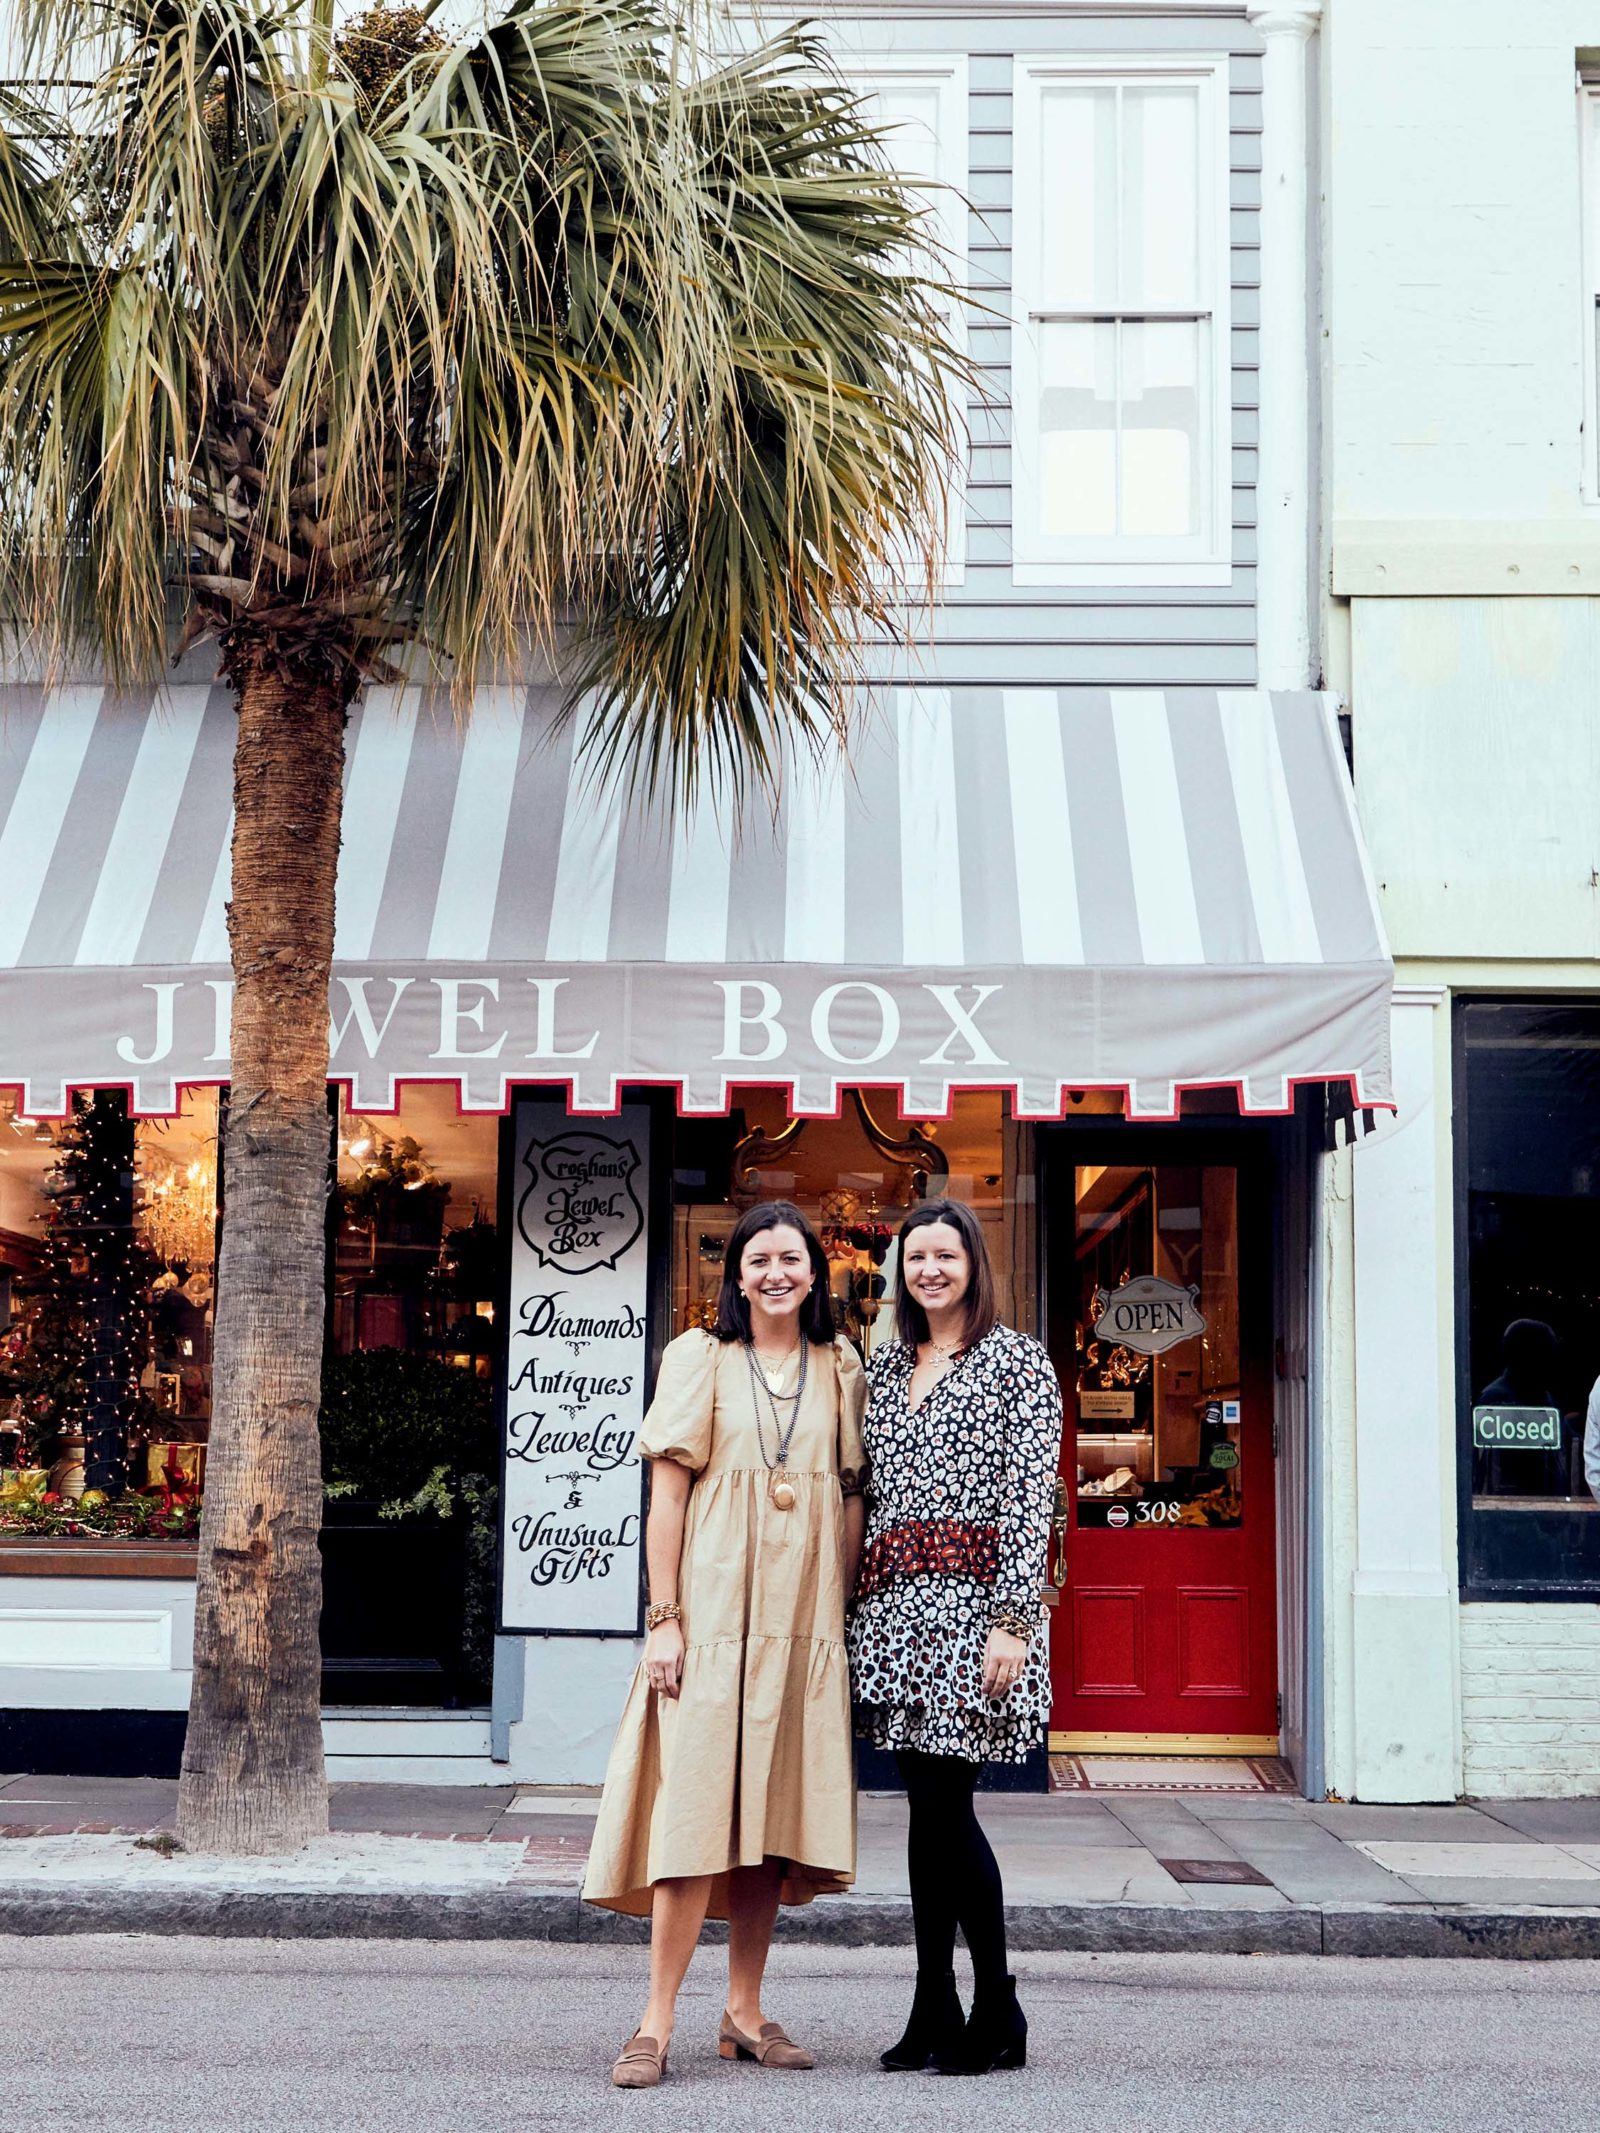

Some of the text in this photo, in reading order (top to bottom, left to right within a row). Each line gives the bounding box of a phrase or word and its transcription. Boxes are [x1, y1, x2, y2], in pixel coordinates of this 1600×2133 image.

[711, 979, 1010, 1066] BOX
[541, 1146, 628, 1188] Croghan's
[544, 1187, 625, 1225] Jewel
[548, 1222, 605, 1255] Box
[513, 1291, 648, 1339] Diamonds
[1115, 1302, 1184, 1331] OPEN
[508, 1357, 634, 1402] Antiques
[506, 1411, 640, 1470] Jewelry
[1479, 1416, 1555, 1441] Closed
[512, 1511, 640, 1552] Unusual
[1134, 1501, 1182, 1523] 308
[531, 1548, 614, 1587] Gifts
